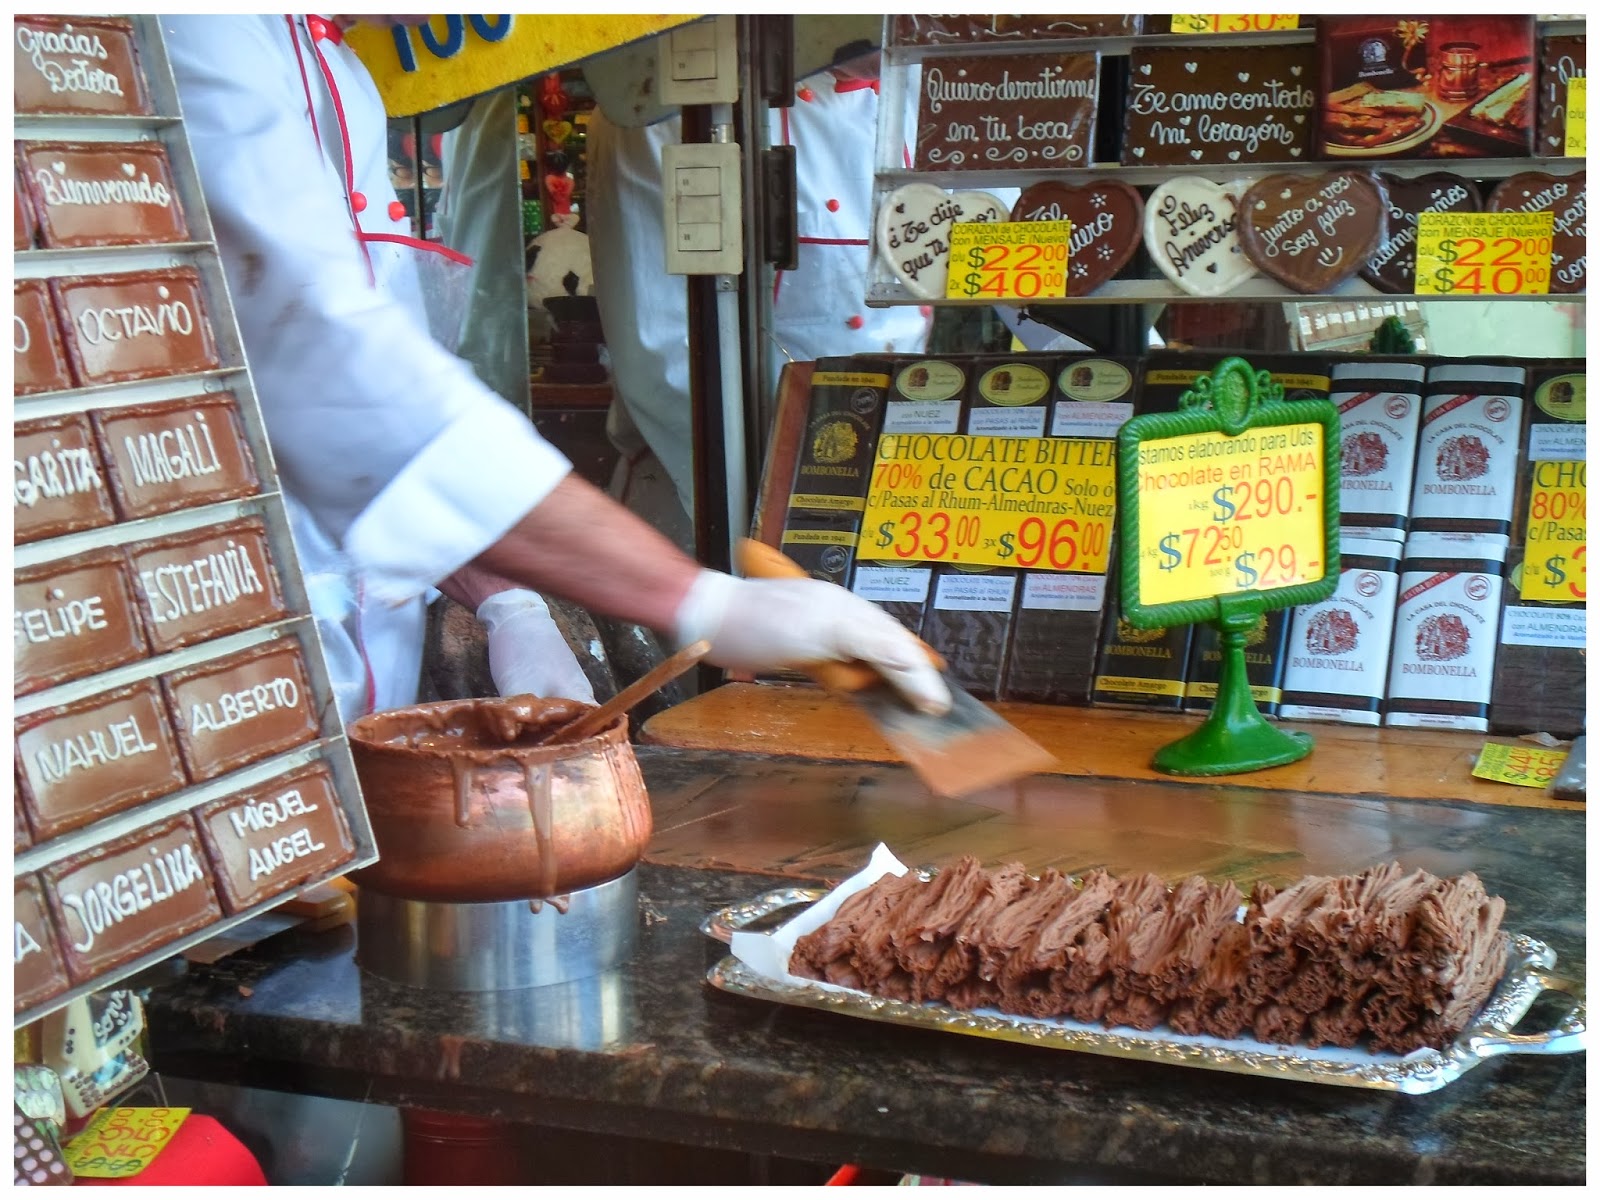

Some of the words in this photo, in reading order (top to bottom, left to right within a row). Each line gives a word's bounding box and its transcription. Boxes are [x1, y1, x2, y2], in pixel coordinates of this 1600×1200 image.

[17, 23, 107, 70] Gracias
[927, 66, 994, 113] Quiero
[1131, 83, 1170, 115] Te
[1170, 91, 1228, 112] amo
[1228, 91, 1271, 110] con
[1263, 79, 1315, 108] todo
[945, 121, 979, 142] en
[1017, 114, 1073, 140] boca
[1150, 120, 1191, 146] mi
[36, 168, 171, 208] Bienvenido
[1012, 221, 1069, 234] CHOCOLATE
[1157, 195, 1216, 236] Feliz
[1317, 199, 1356, 237] feliz
[1488, 213, 1553, 226] CHOCOLATE
[973, 235, 1027, 246] MENSAJE
[1442, 227, 1504, 239] MENSAJE
[879, 435, 1032, 463] CHOCOLATE
[1139, 443, 1185, 466] stamos
[1188, 435, 1256, 460] elaborando
[1260, 433, 1287, 452] para
[1229, 462, 1252, 480] en
[1259, 451, 1317, 476] RAMA
[875, 463, 922, 490] 70%
[929, 463, 957, 491] de
[963, 465, 1059, 495] CACAO
[1064, 478, 1100, 498] Solo
[1423, 484, 1497, 496] BOMBONELLA
[922, 492, 935, 509] al
[1292, 657, 1365, 672] BOMBONELLA
[1402, 663, 1477, 678] BOMBONELLA
[190, 677, 299, 738] ALBERTO
[247, 827, 326, 882] ANGEL
